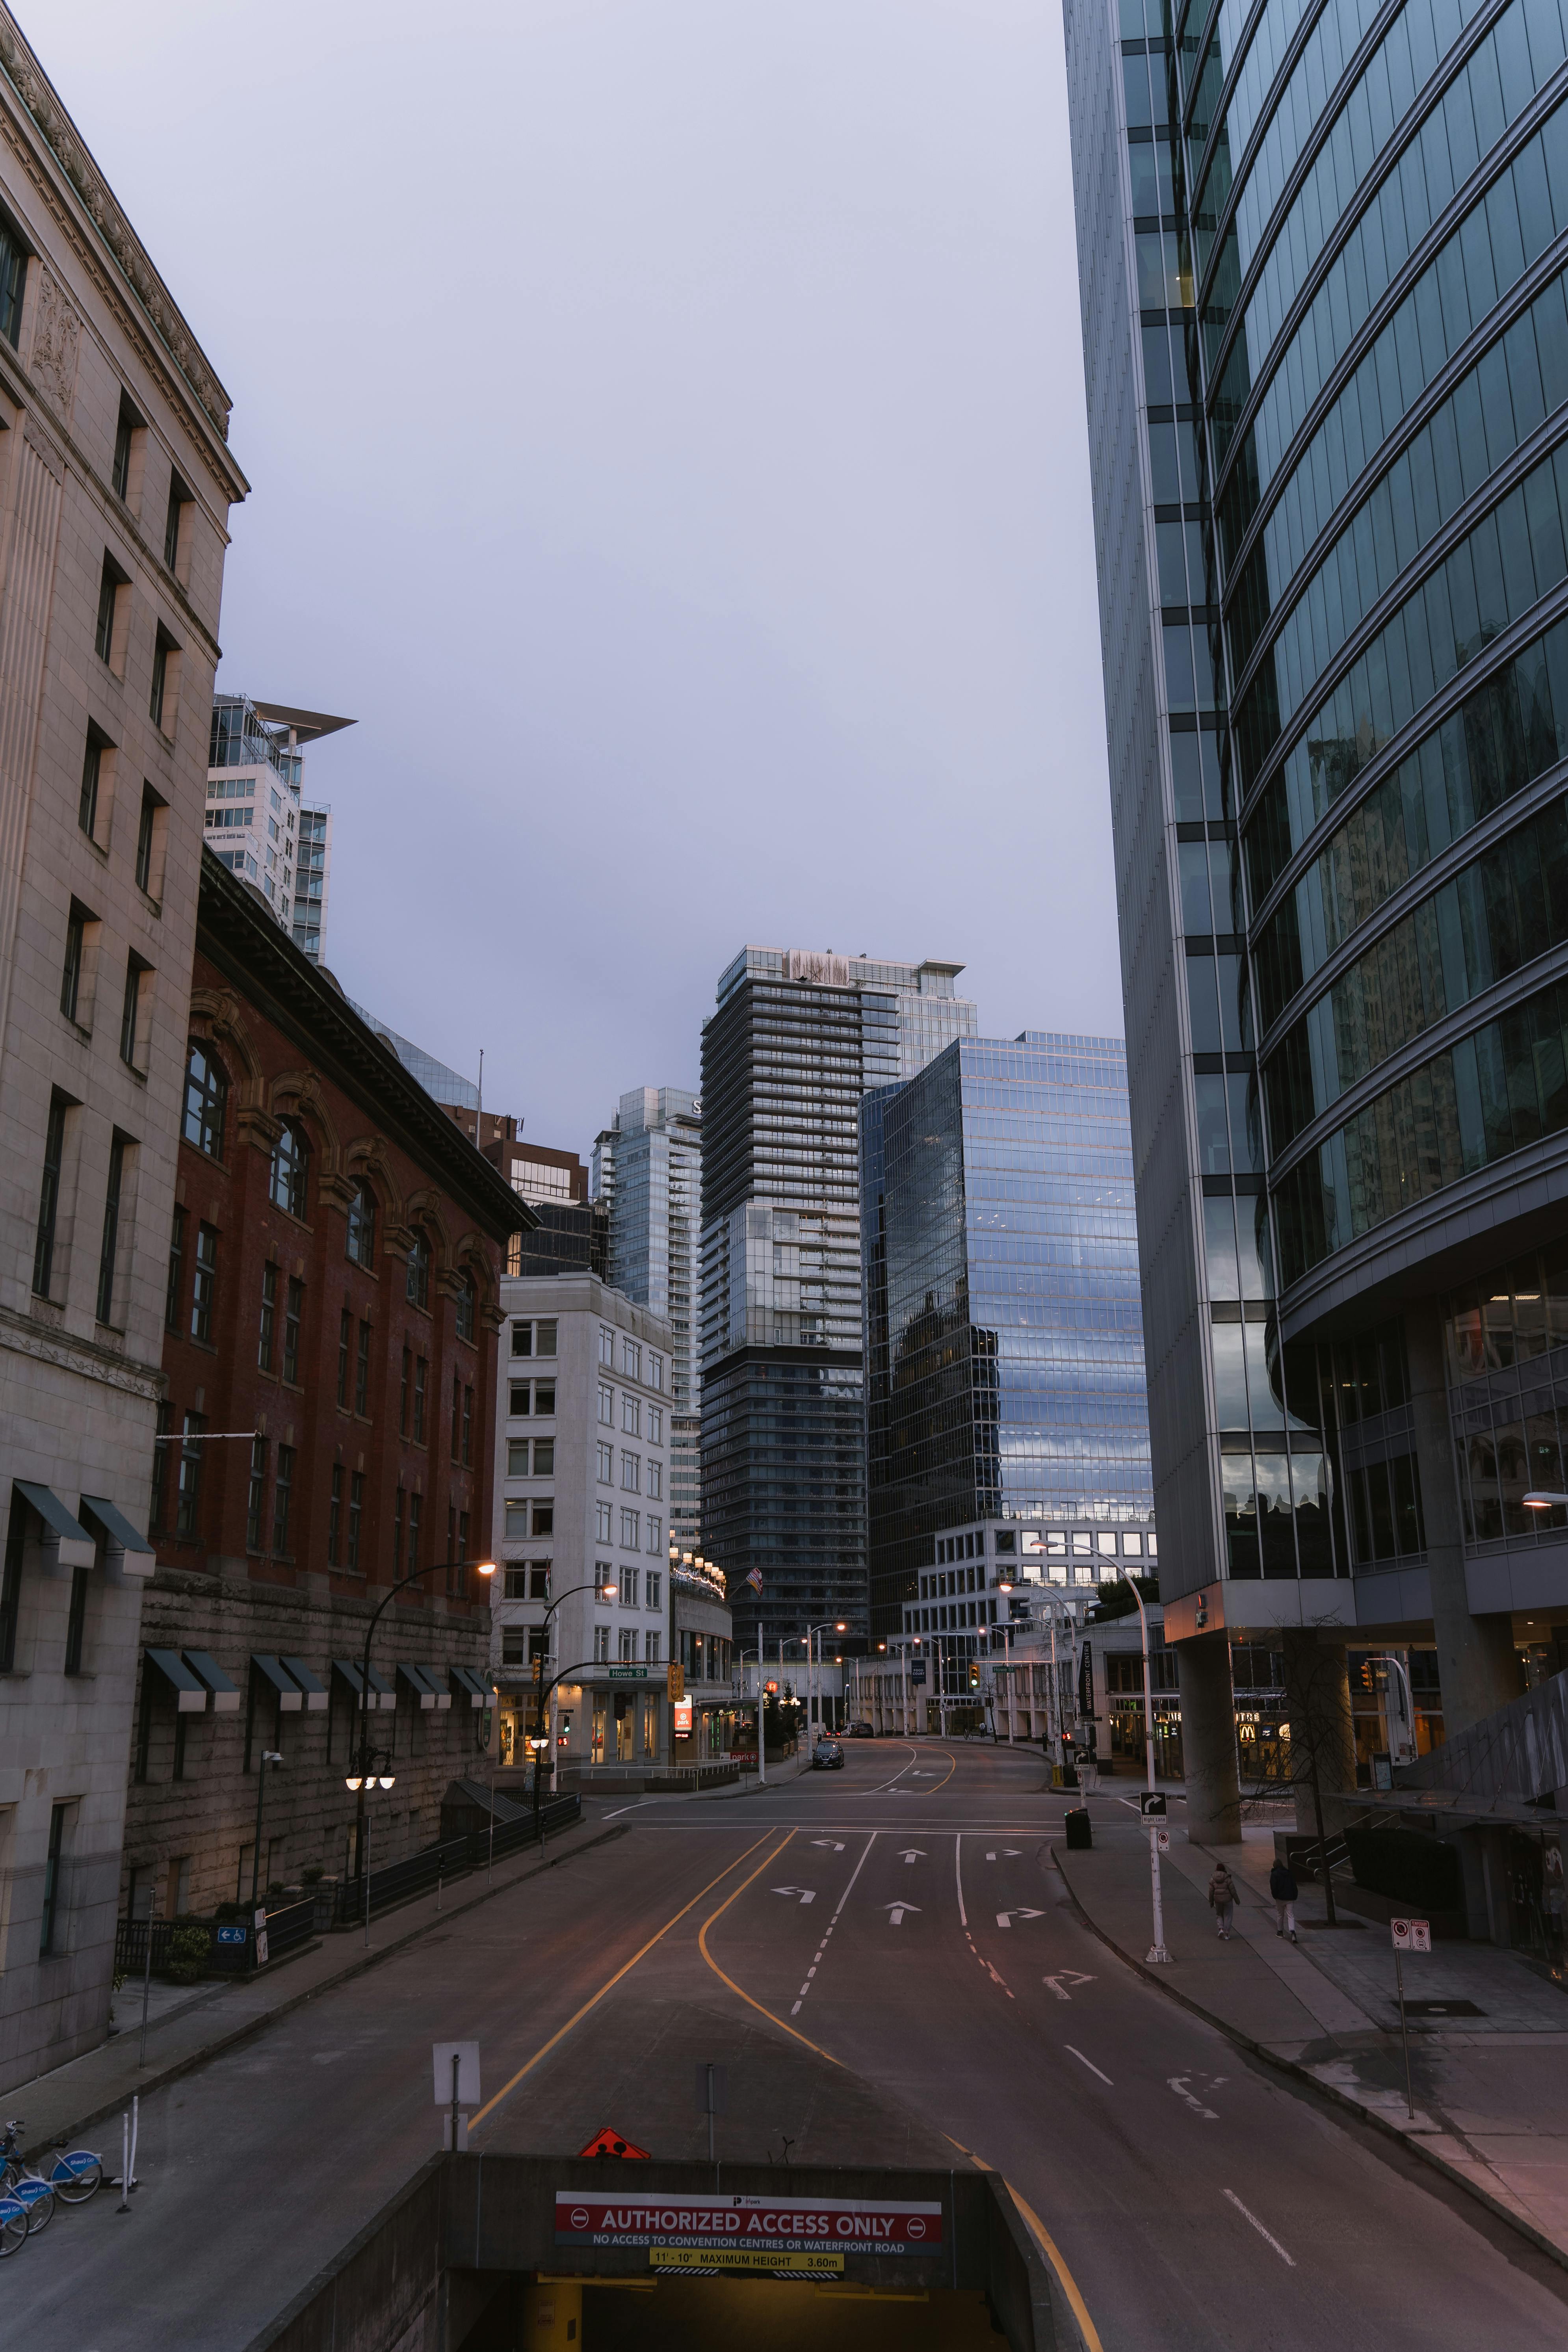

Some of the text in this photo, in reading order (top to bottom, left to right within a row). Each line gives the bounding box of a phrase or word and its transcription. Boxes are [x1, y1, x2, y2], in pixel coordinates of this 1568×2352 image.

[601, 2210, 895, 2237] AUTHORIZED ACCESS ONLY
[594, 2234, 905, 2253] NO ACCESS TO CONVENTION CENTRES OR WATERFRONT ROAD
[656, 2253, 669, 2262] 11'
[678, 2254, 693, 2263] 10"
[700, 2254, 749, 2265] MAXIMUM
[753, 2256, 791, 2267] HEIGHT
[807, 2258, 837, 2268] 3.60m
